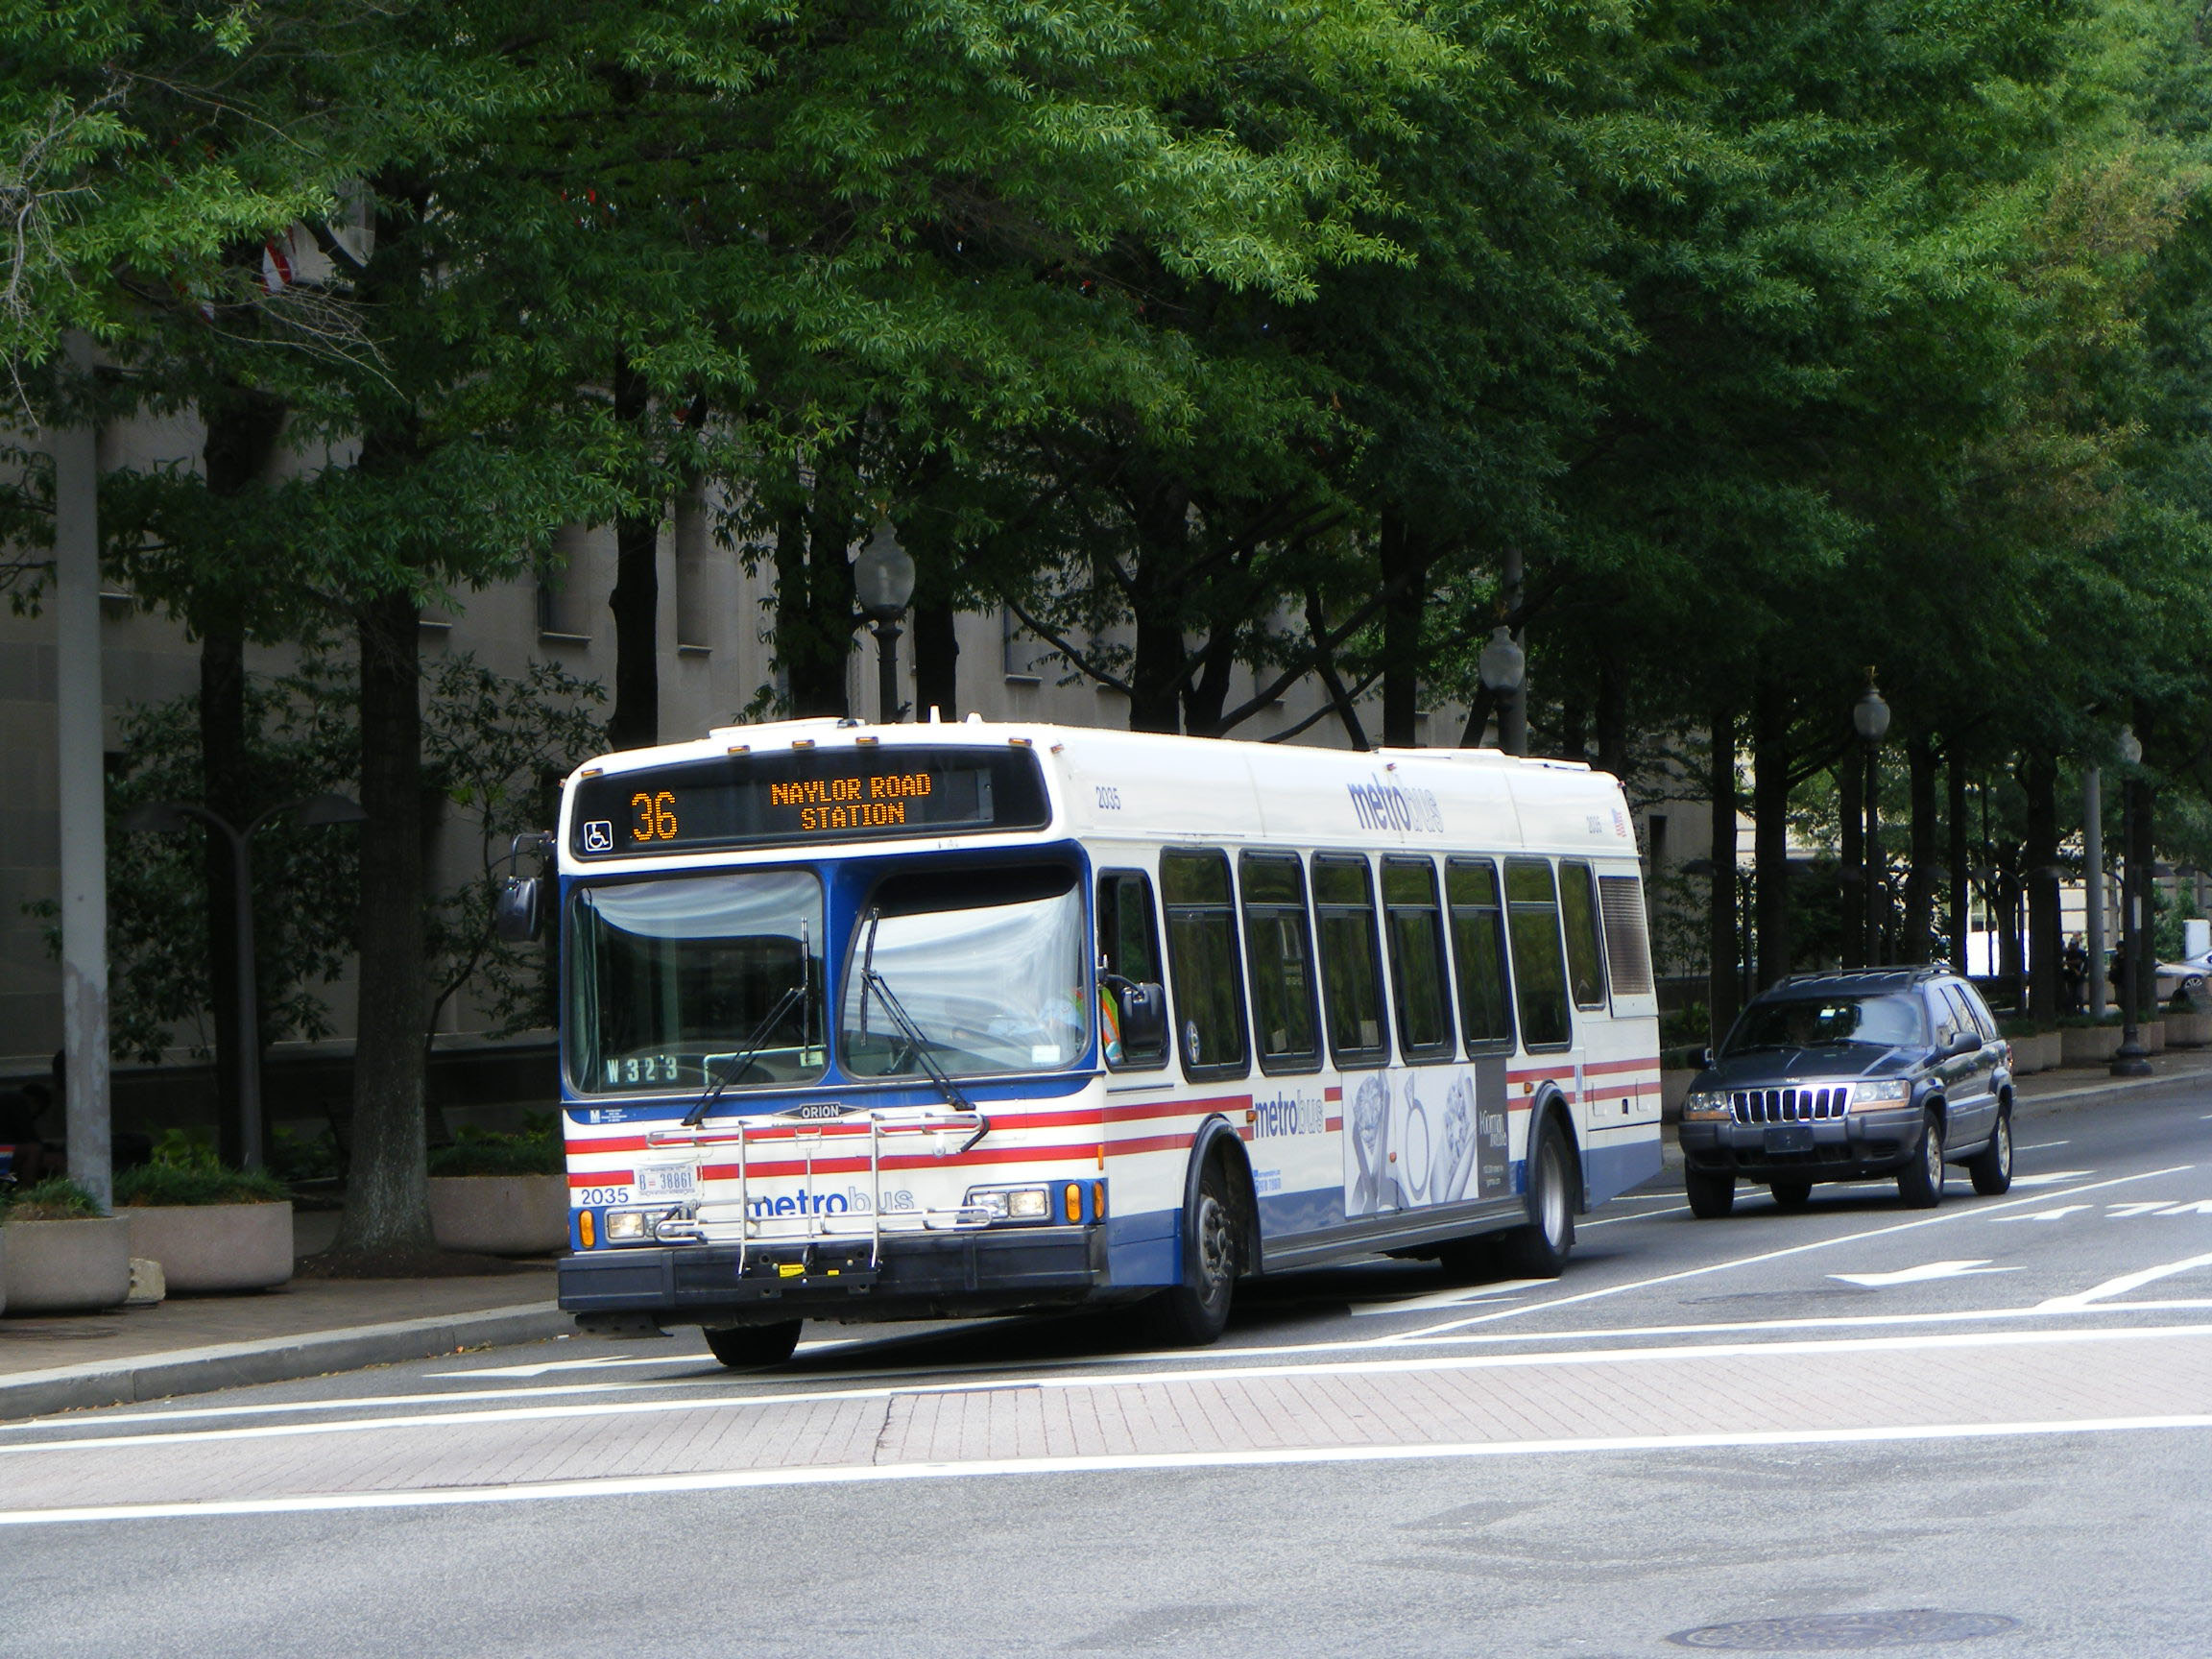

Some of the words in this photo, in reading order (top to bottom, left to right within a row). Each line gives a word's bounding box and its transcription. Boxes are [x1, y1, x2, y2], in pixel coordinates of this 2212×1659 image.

[772, 778, 862, 805] NAYLOR
[870, 773, 931, 799] ROAD
[1095, 786, 1121, 809] 2035
[1347, 772, 1444, 833] metrobus
[631, 791, 678, 841] 36
[801, 802, 905, 830] STATION
[802, 1105, 839, 1118] ORION
[1255, 1089, 1324, 1139] metrobus
[660, 1171, 692, 1190] 38861
[581, 1187, 630, 1205] 2035
[745, 1186, 915, 1217] metrobus
